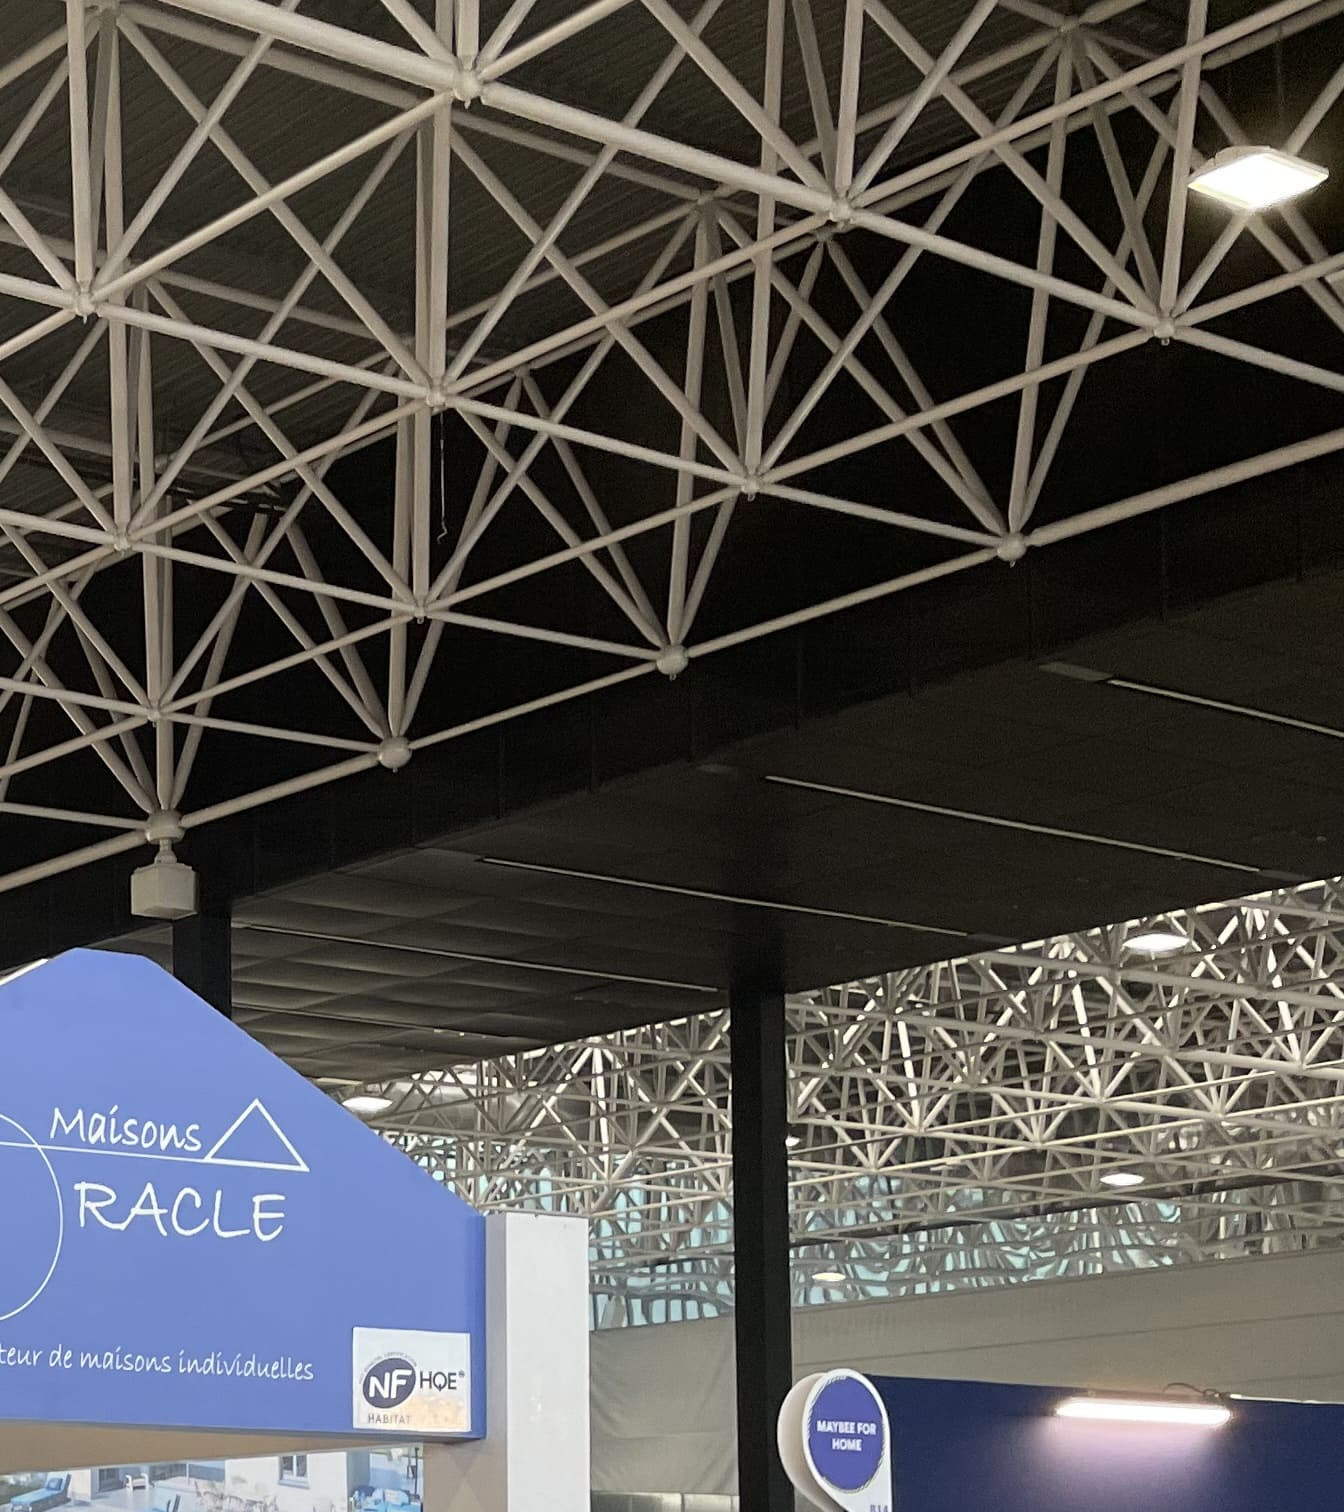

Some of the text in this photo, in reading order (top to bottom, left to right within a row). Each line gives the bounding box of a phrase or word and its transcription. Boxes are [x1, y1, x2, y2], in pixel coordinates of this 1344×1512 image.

[50, 1105, 202, 1152] Maisons
[74, 1182, 285, 1241] RACLE
[49, 1344, 73, 1368] de
[80, 1349, 171, 1374] maisons
[178, 1349, 314, 1381] individuelles
[369, 1369, 412, 1399] NF
[368, 1413, 411, 1425] HABITAT
[817, 1420, 877, 1435] MAYBEE FOR
[832, 1438, 862, 1451] HOME
